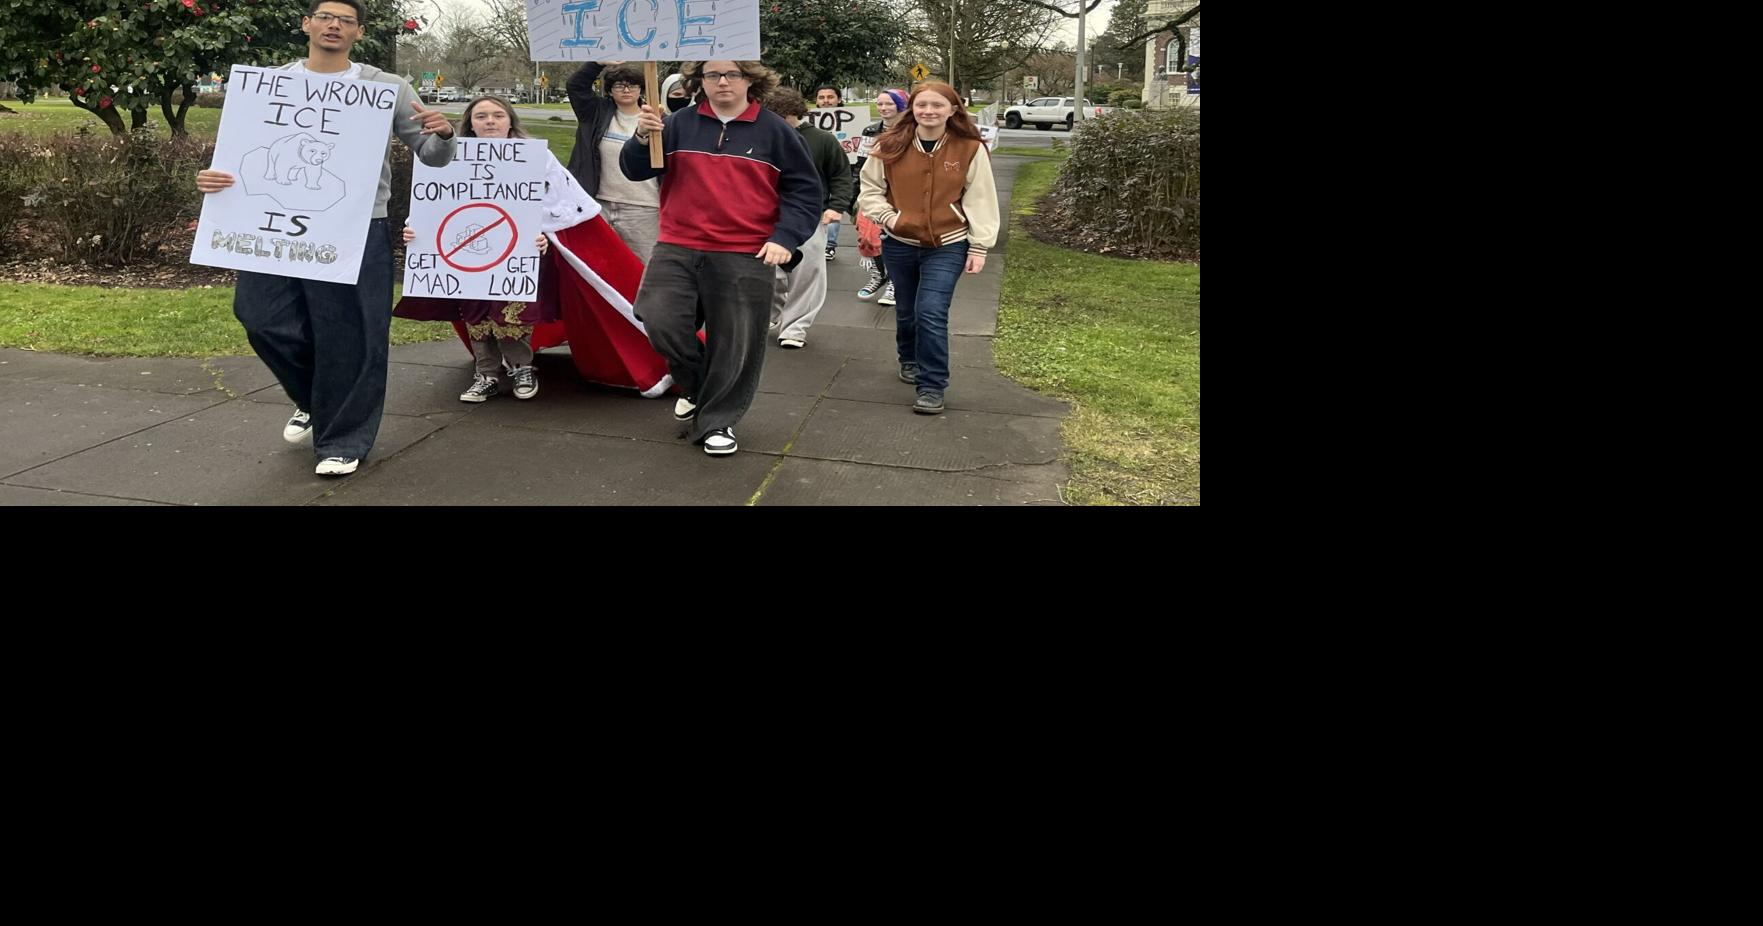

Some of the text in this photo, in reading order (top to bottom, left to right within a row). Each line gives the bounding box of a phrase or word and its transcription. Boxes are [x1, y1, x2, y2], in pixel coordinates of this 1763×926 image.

[235, 70, 395, 110] THE WRONG
[264, 102, 342, 135] ICE
[803, 109, 855, 132] TOP
[452, 141, 527, 163] ILENCE
[469, 163, 496, 181] IS
[413, 181, 542, 201] COMPLIANCE
[258, 211, 311, 237] IS
[211, 228, 337, 265] MELTING
[407, 253, 441, 270] GET
[507, 256, 540, 273] GET
[410, 272, 462, 296] MAD.
[488, 274, 536, 296] LOUD
